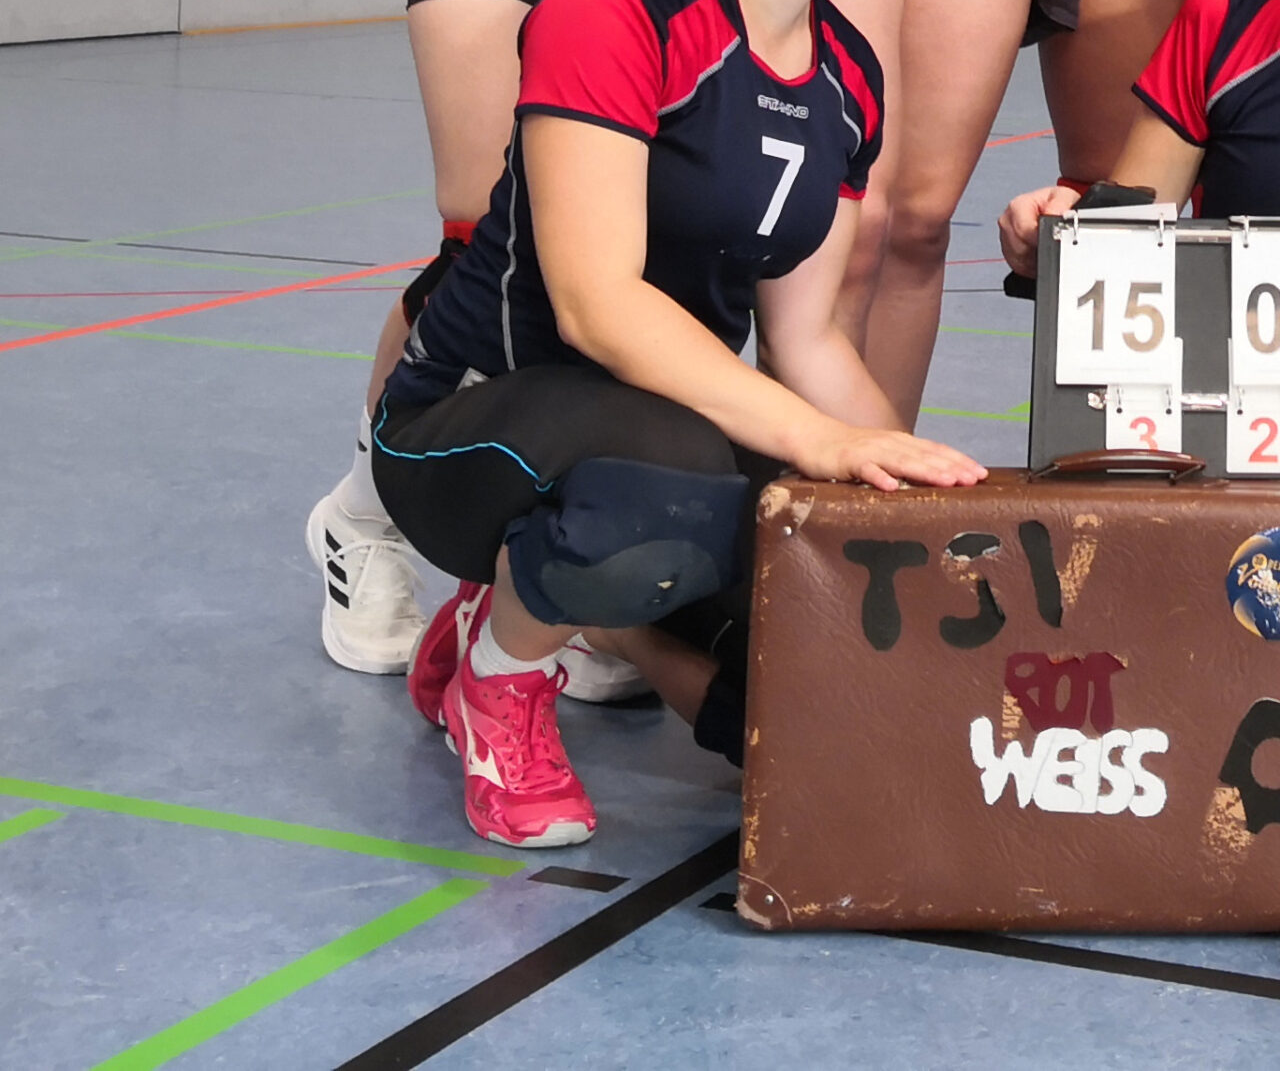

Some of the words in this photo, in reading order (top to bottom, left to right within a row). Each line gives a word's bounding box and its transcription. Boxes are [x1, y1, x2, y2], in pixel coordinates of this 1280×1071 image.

[757, 136, 805, 236] 7
[1076, 279, 1165, 352] 15
[1248, 417, 1279, 463] 2
[1003, 651, 1127, 734] ROT
[969, 716, 1169, 817] WEISS
